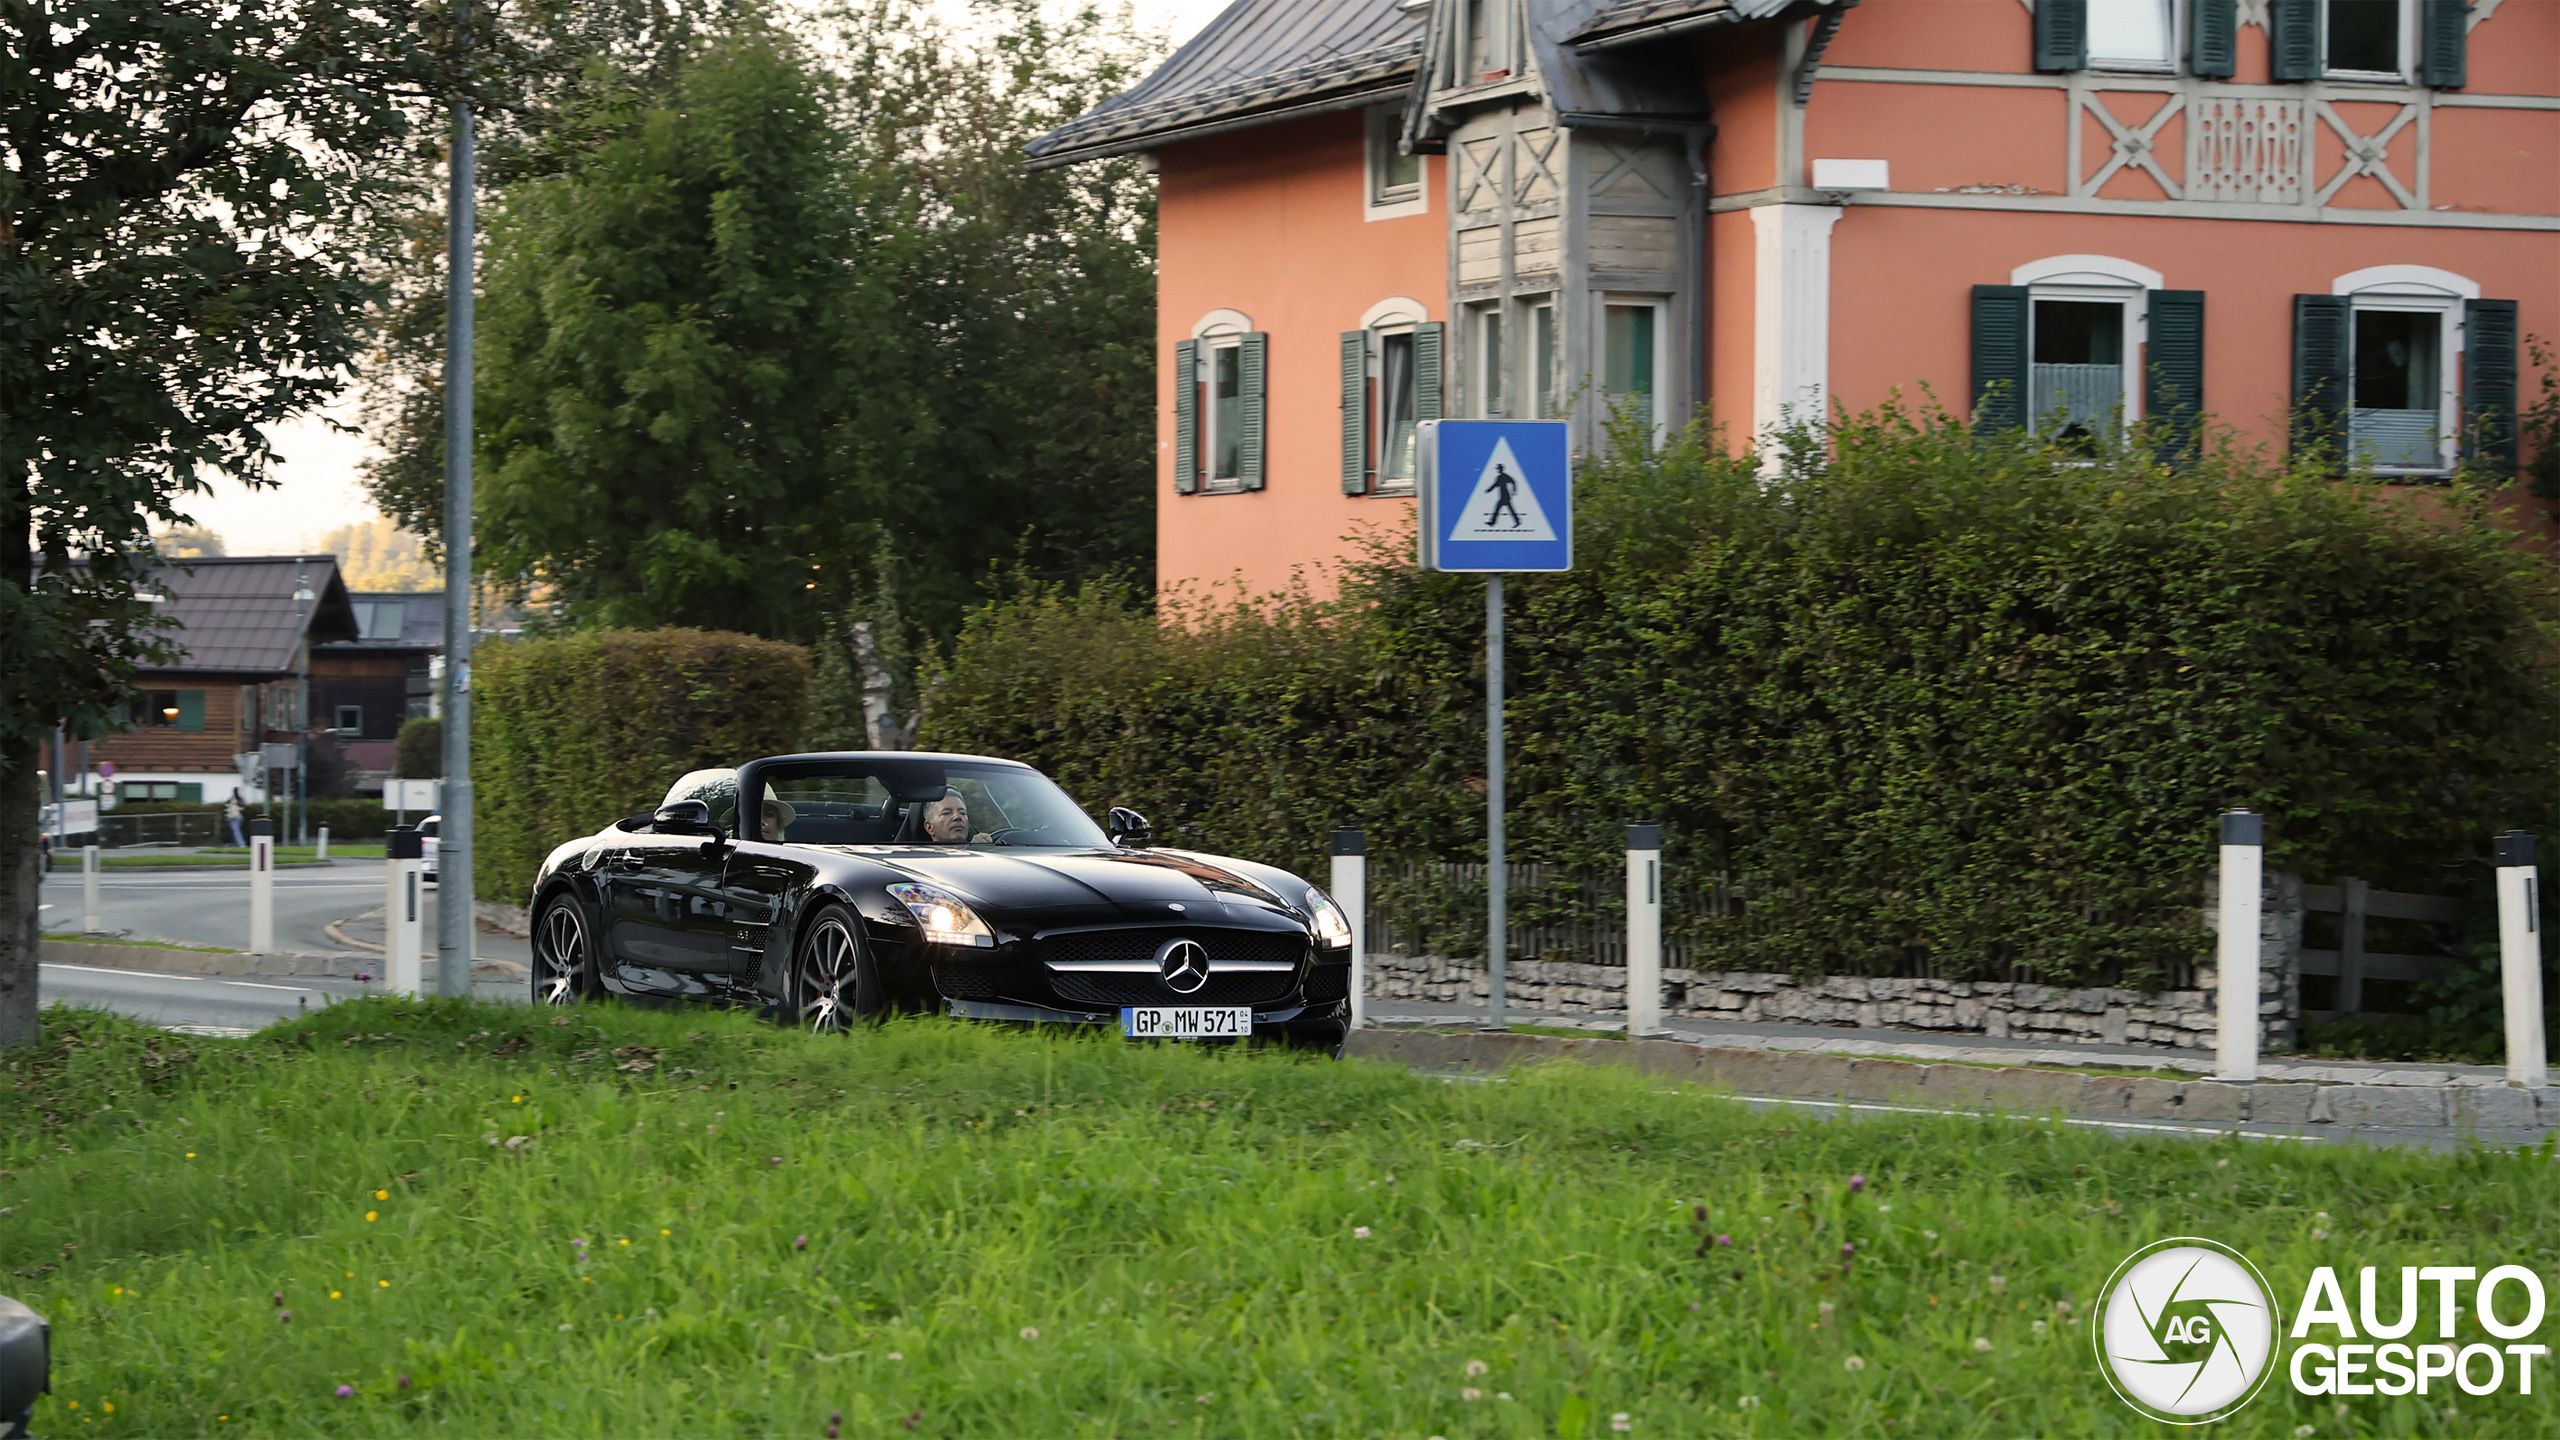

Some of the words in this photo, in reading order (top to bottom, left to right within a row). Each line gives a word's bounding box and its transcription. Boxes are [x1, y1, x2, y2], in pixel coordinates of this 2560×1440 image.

[1136, 1010, 1161, 1033] GP
[1174, 1010, 1199, 1033] MW
[1204, 1010, 1238, 1033] 571
